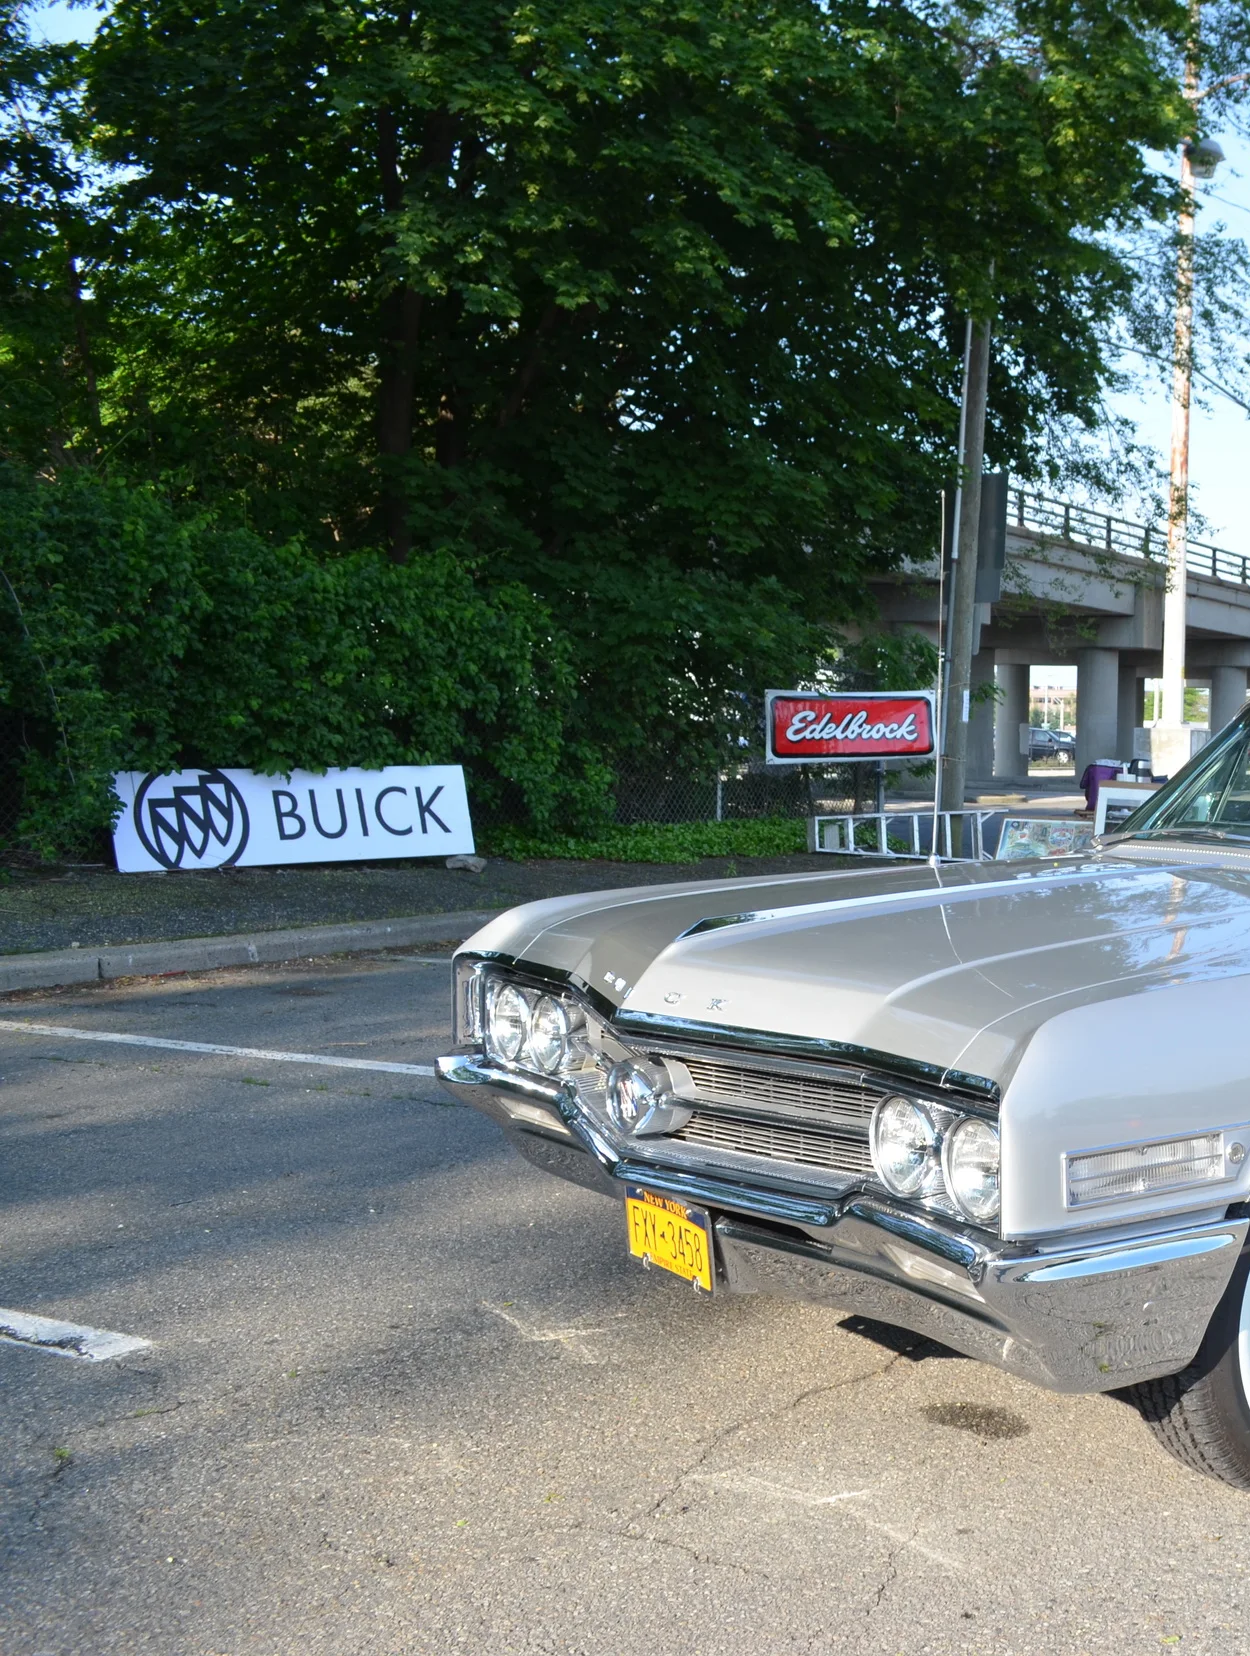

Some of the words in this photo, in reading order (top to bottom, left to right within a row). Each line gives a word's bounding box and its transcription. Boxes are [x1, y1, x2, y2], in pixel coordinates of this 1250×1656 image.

[785, 710, 918, 742] Edelbrock
[272, 785, 452, 841] BUICK
[644, 1191, 664, 1208] NEW
[664, 1198, 688, 1219] YORK
